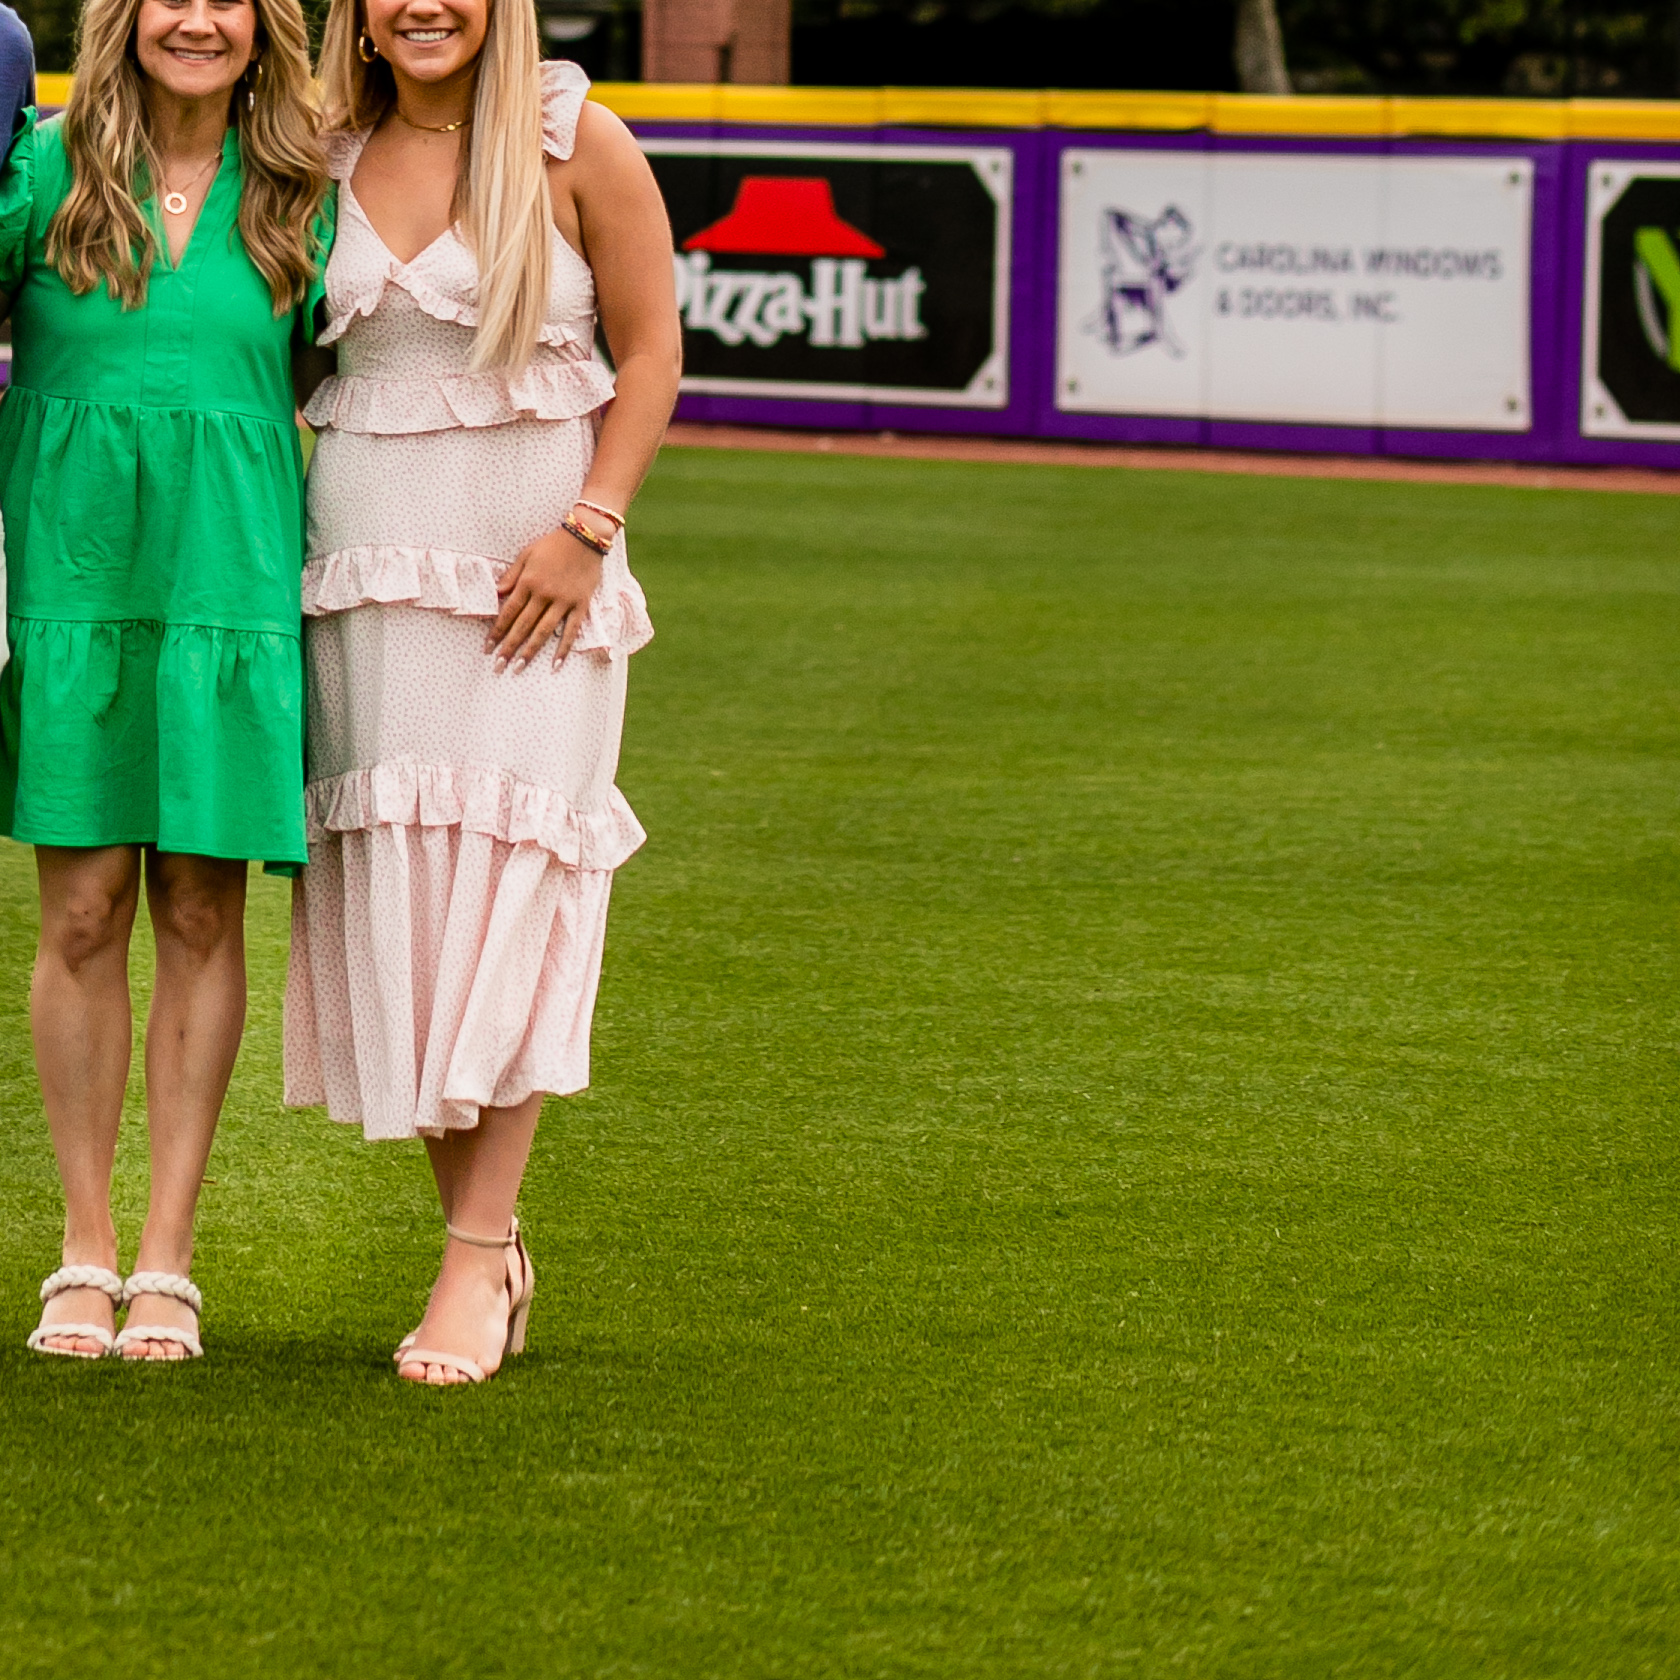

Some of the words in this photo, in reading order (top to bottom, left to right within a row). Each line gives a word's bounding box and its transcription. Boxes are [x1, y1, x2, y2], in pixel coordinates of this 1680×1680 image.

[1217, 243, 1354, 275] CAROLINA
[1366, 246, 1504, 281] WINDOWS
[808, 257, 928, 348] Hut
[1216, 289, 1231, 318] &
